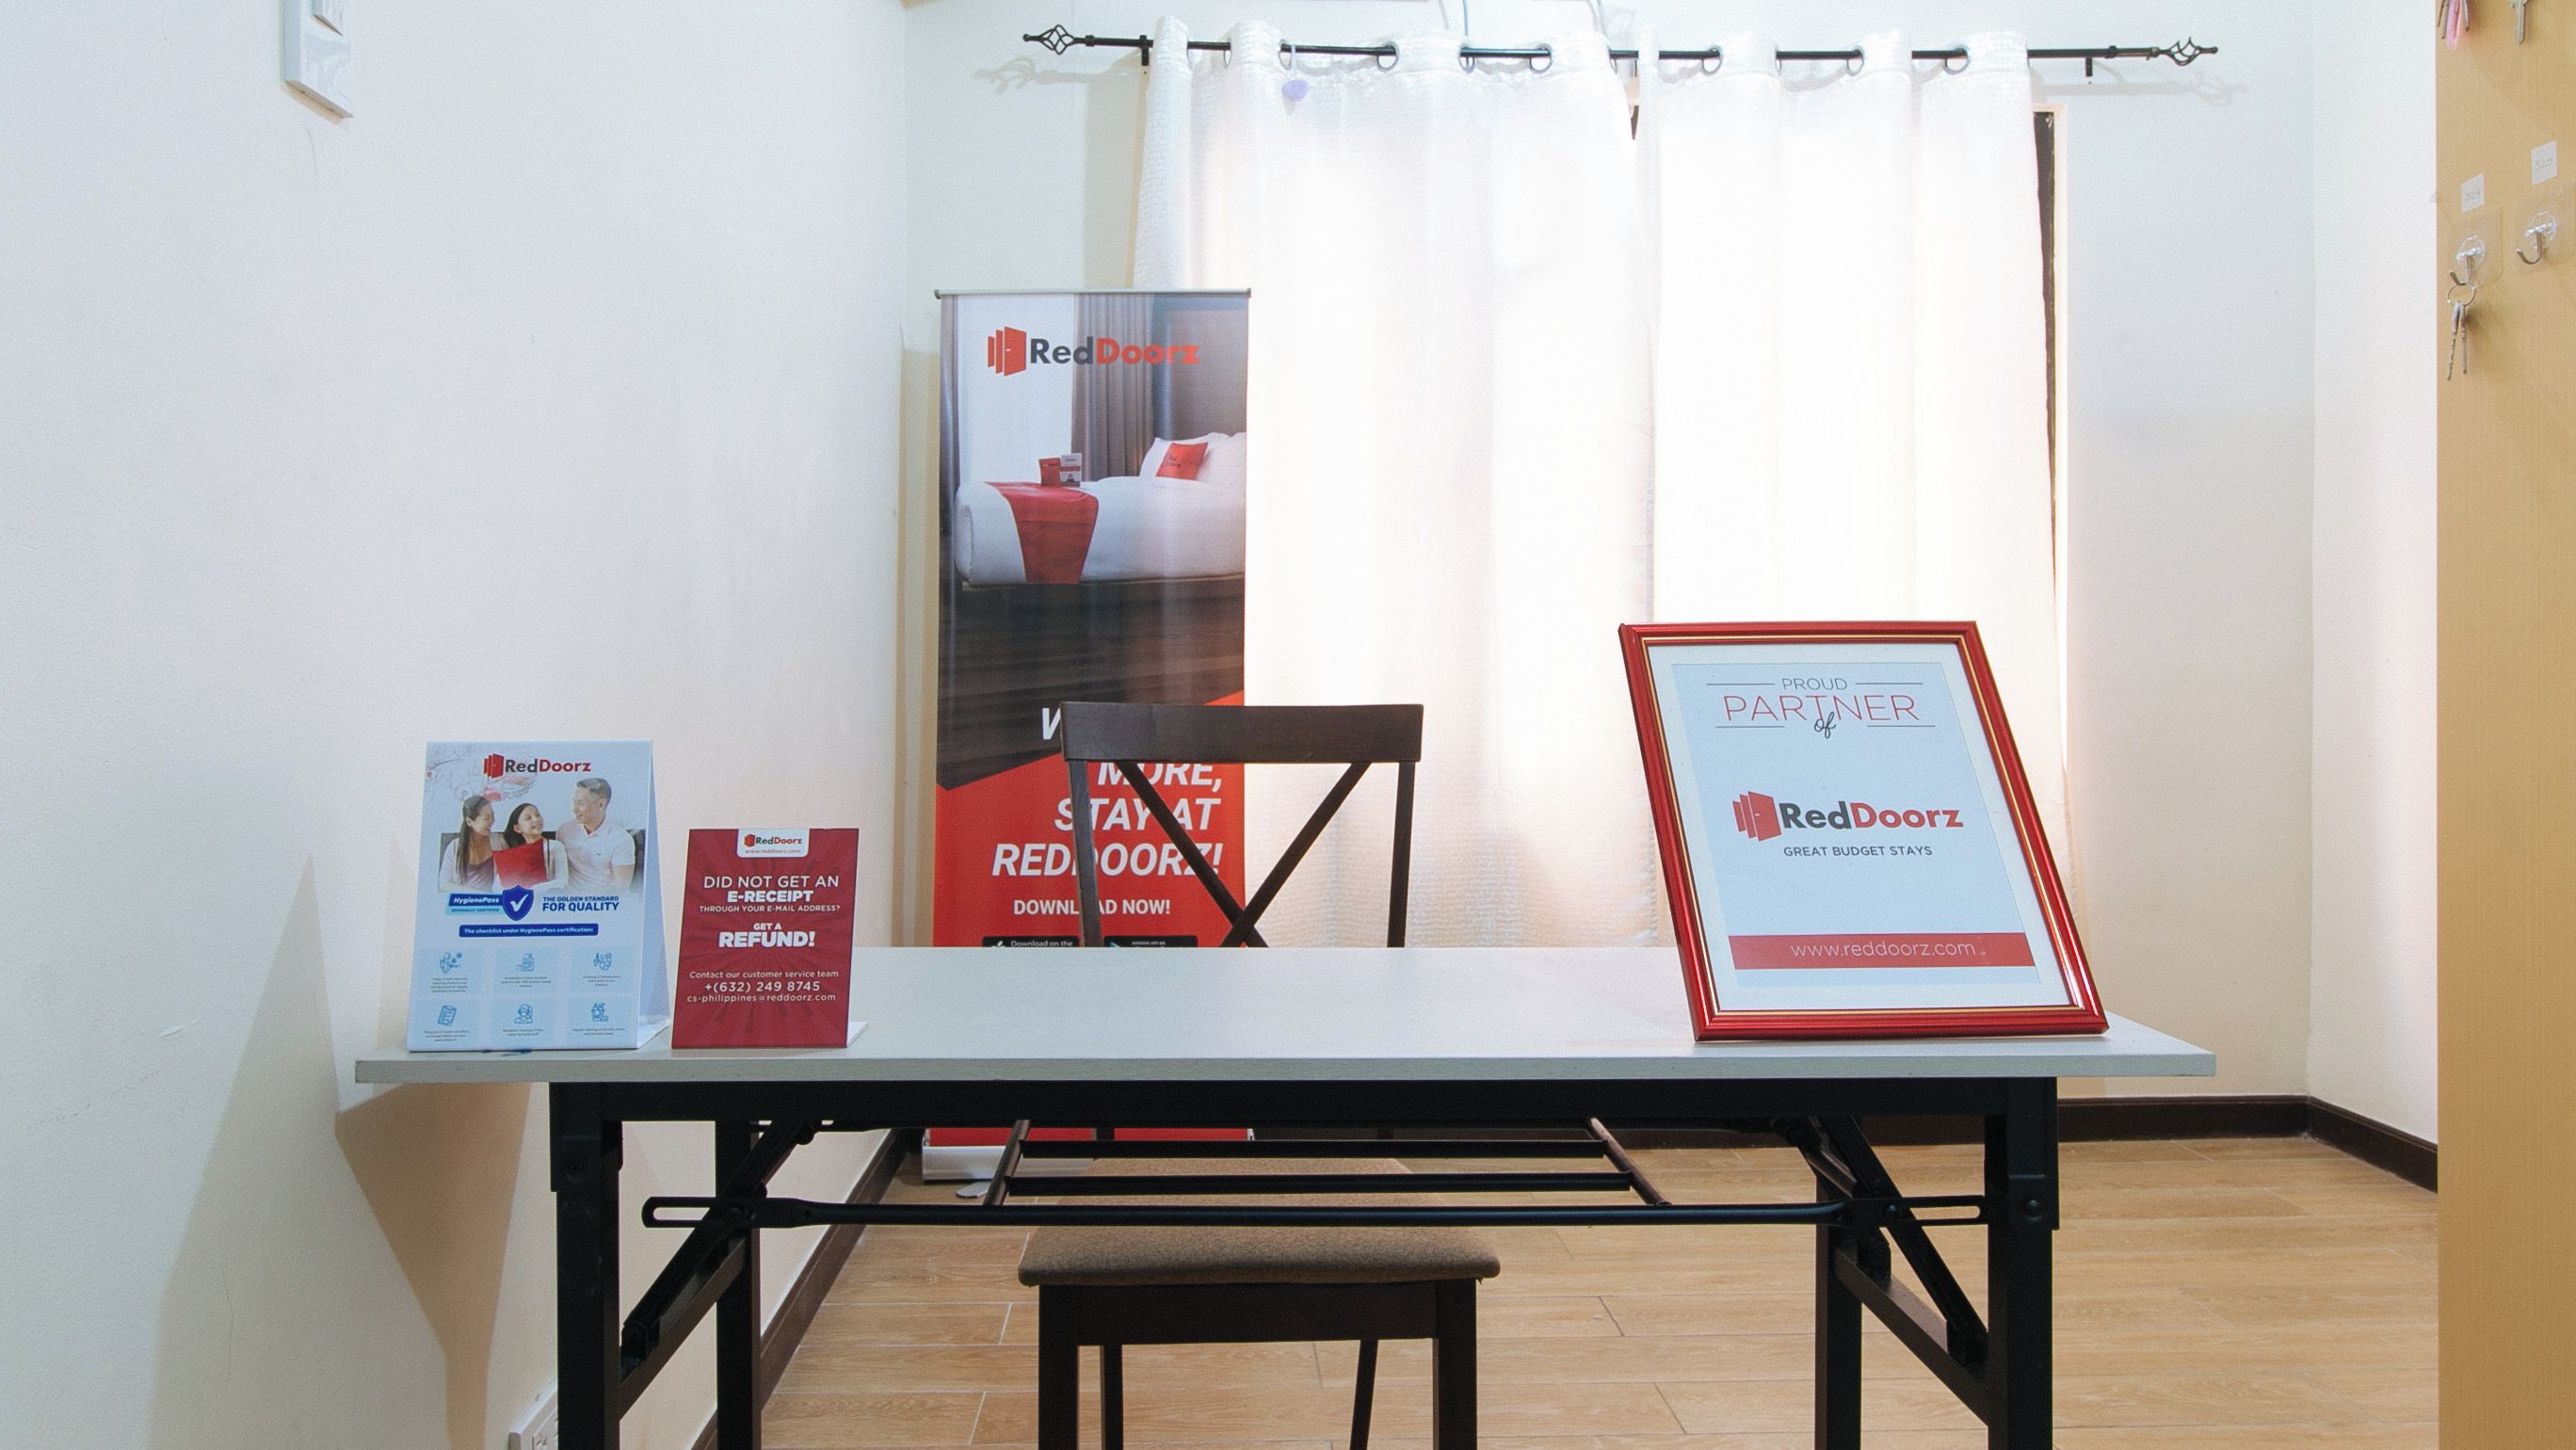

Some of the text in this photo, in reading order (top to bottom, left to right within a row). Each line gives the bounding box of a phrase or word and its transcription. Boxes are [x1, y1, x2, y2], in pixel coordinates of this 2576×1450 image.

[1030, 336, 1199, 365] RedDoorz
[1781, 678, 1847, 691] PROUD
[1723, 695, 1920, 721] PARTNER
[1813, 711, 1836, 739] of
[505, 758, 592, 773] RedDoorz
[1171, 798, 1221, 830] AT
[1779, 800, 1964, 830] RedDoorz
[755, 836, 802, 845] RedDoorz
[1783, 846, 1933, 857] GREAT BUDGET STAYS
[703, 875, 839, 889] DID NOT GET AN
[727, 890, 814, 903] E-RECEIPT
[542, 902, 620, 912] FOR QUALITY
[797, 904, 841, 912] ADDRESS?
[1122, 899, 1170, 915] NOW!
[718, 930, 816, 948] REFUND!
[1790, 941, 1976, 958] www.reddoorz.com
[705, 981, 820, 993] +(632) 249 8745
